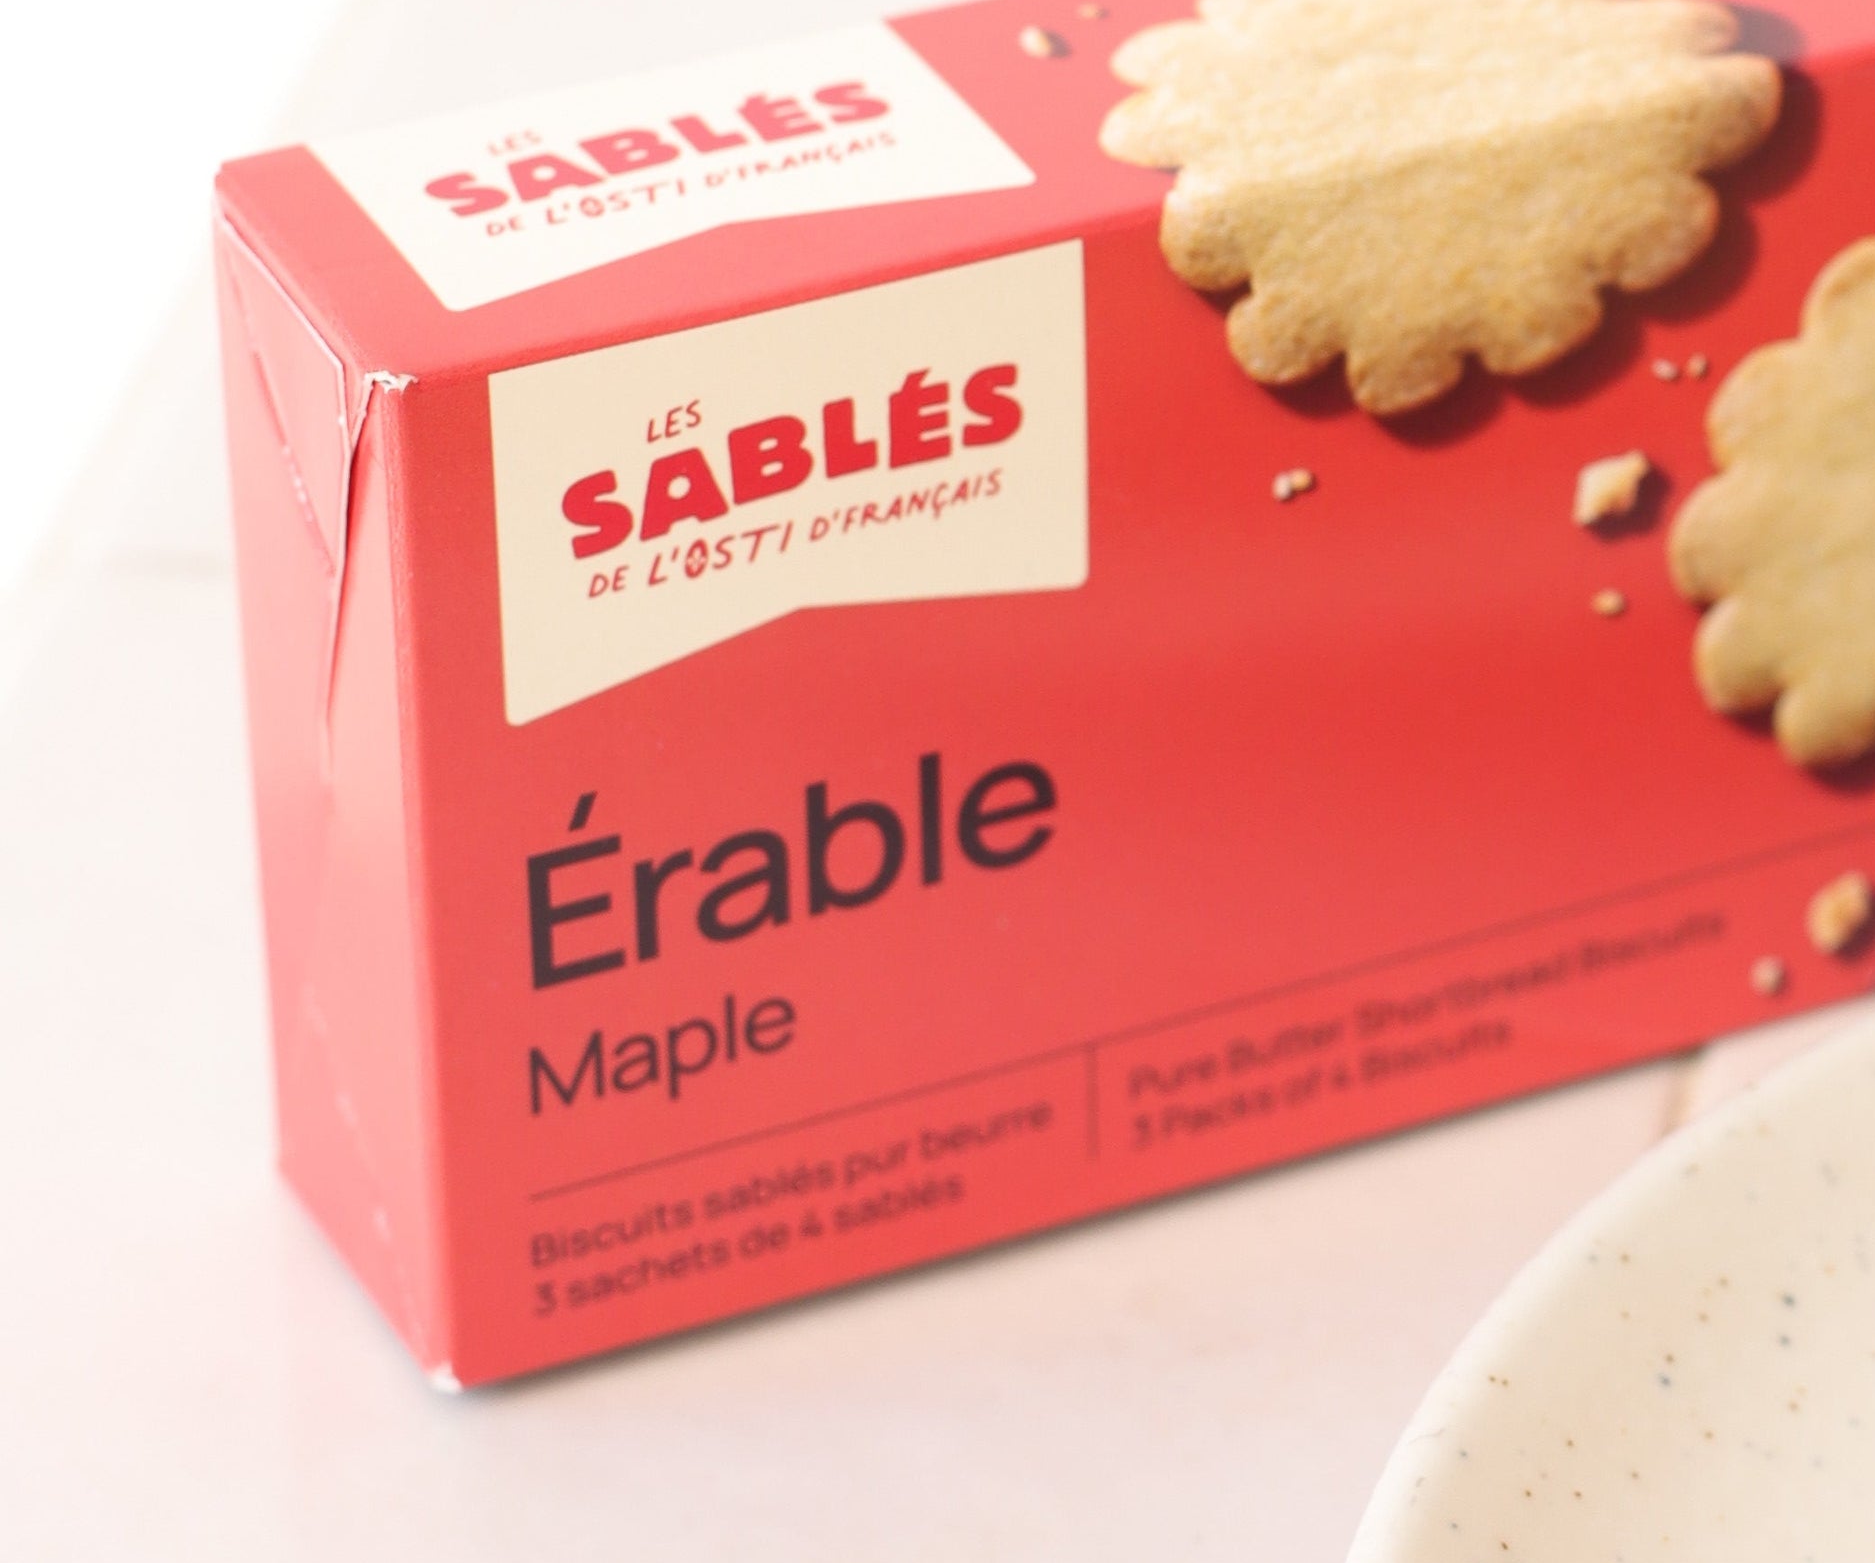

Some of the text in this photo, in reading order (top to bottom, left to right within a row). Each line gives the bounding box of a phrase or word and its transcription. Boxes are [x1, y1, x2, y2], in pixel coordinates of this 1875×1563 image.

[424, 80, 892, 219] SABLÉS
[488, 129, 543, 157] LES
[485, 214, 526, 238] DE
[560, 362, 1024, 560] SABLÉS
[647, 399, 702, 445] LES
[588, 469, 1003, 599] DE L'OSTI D'FRANÇAIS
[526, 750, 1058, 991] Érable
[528, 994, 797, 1116] Maple
[1127, 1052, 1220, 1098] Pure
[1225, 1018, 1344, 1075] Butter
[1355, 952, 1573, 1037] Shortbread
[529, 1100, 1055, 1269] Biscuits sablés pur beurre
[534, 1172, 965, 1318] 3 sachets de 4 sablés
